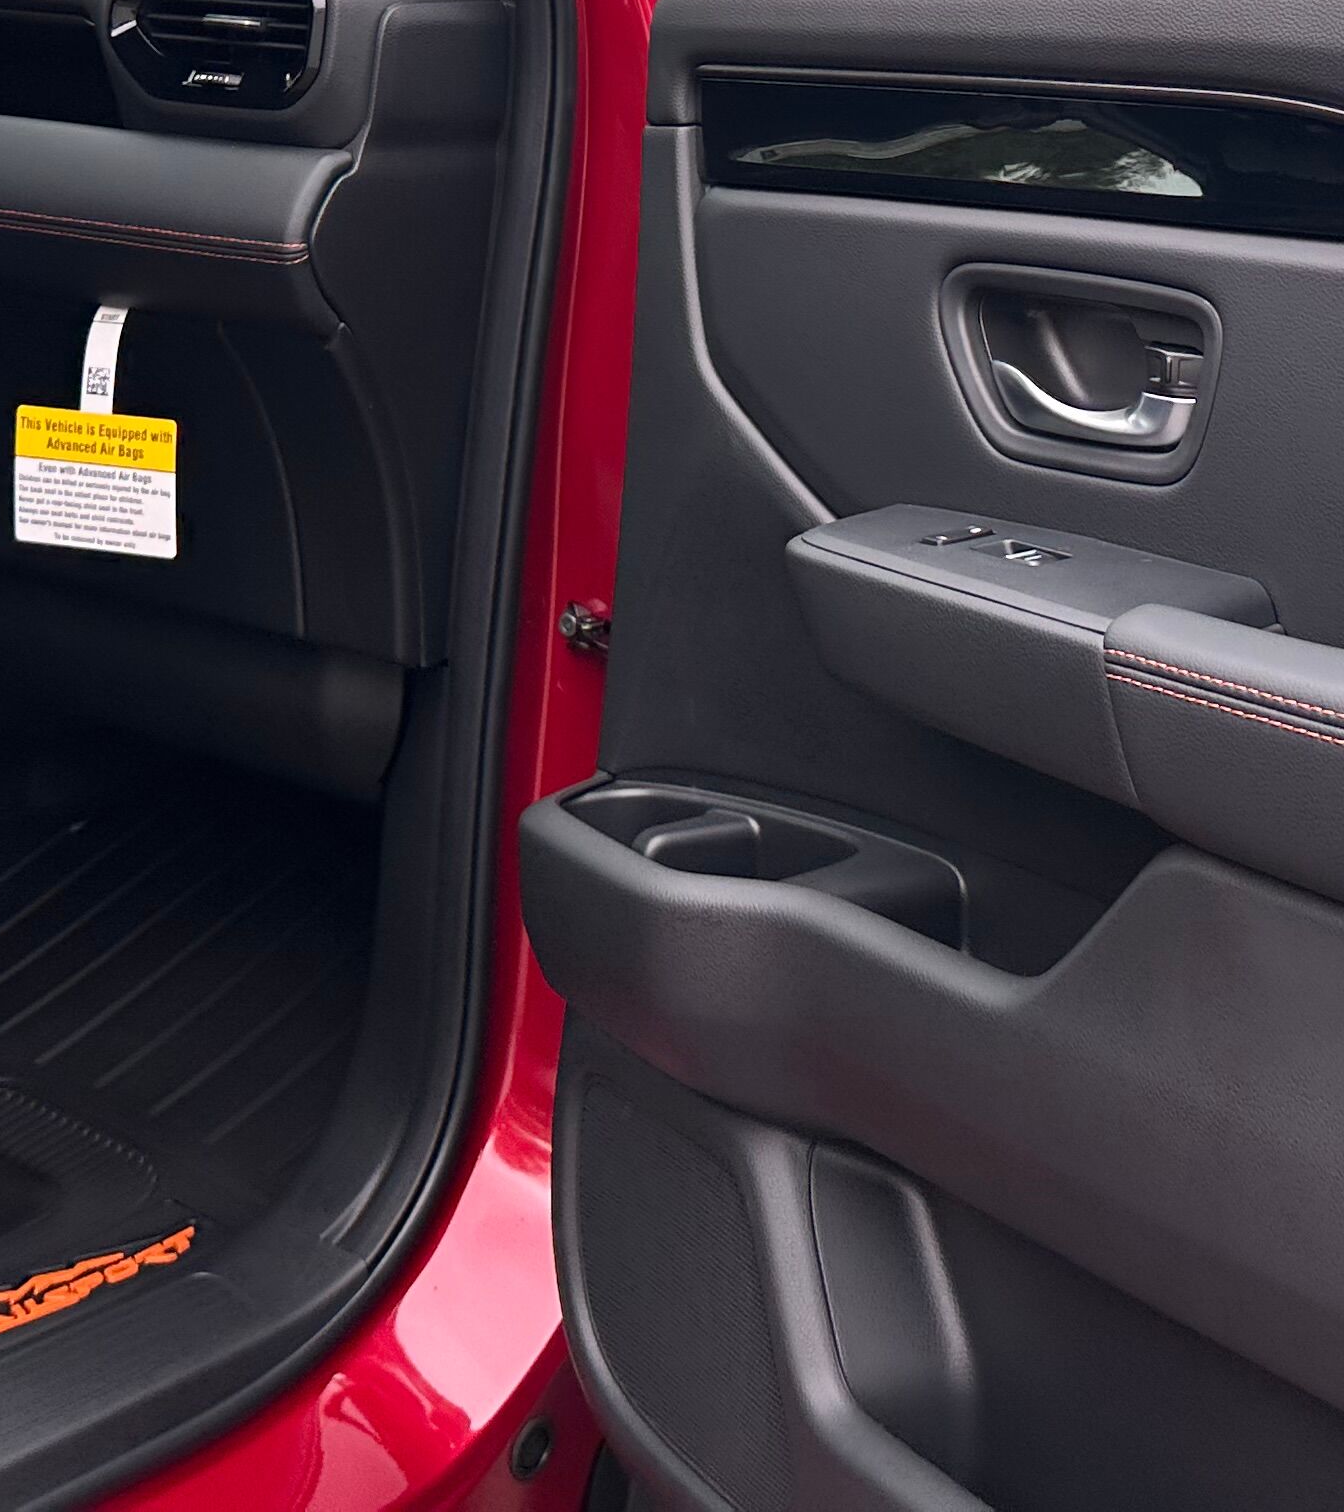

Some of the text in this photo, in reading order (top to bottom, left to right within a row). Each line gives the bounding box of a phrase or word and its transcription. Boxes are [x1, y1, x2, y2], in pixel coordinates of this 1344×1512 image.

[20, 415, 172, 444] This Vehicle is Equipped with
[47, 436, 144, 461] Advanced Air Bags
[78, 466, 116, 480] Advanced
[118, 470, 130, 481] Air
[132, 471, 152, 485] Bags
